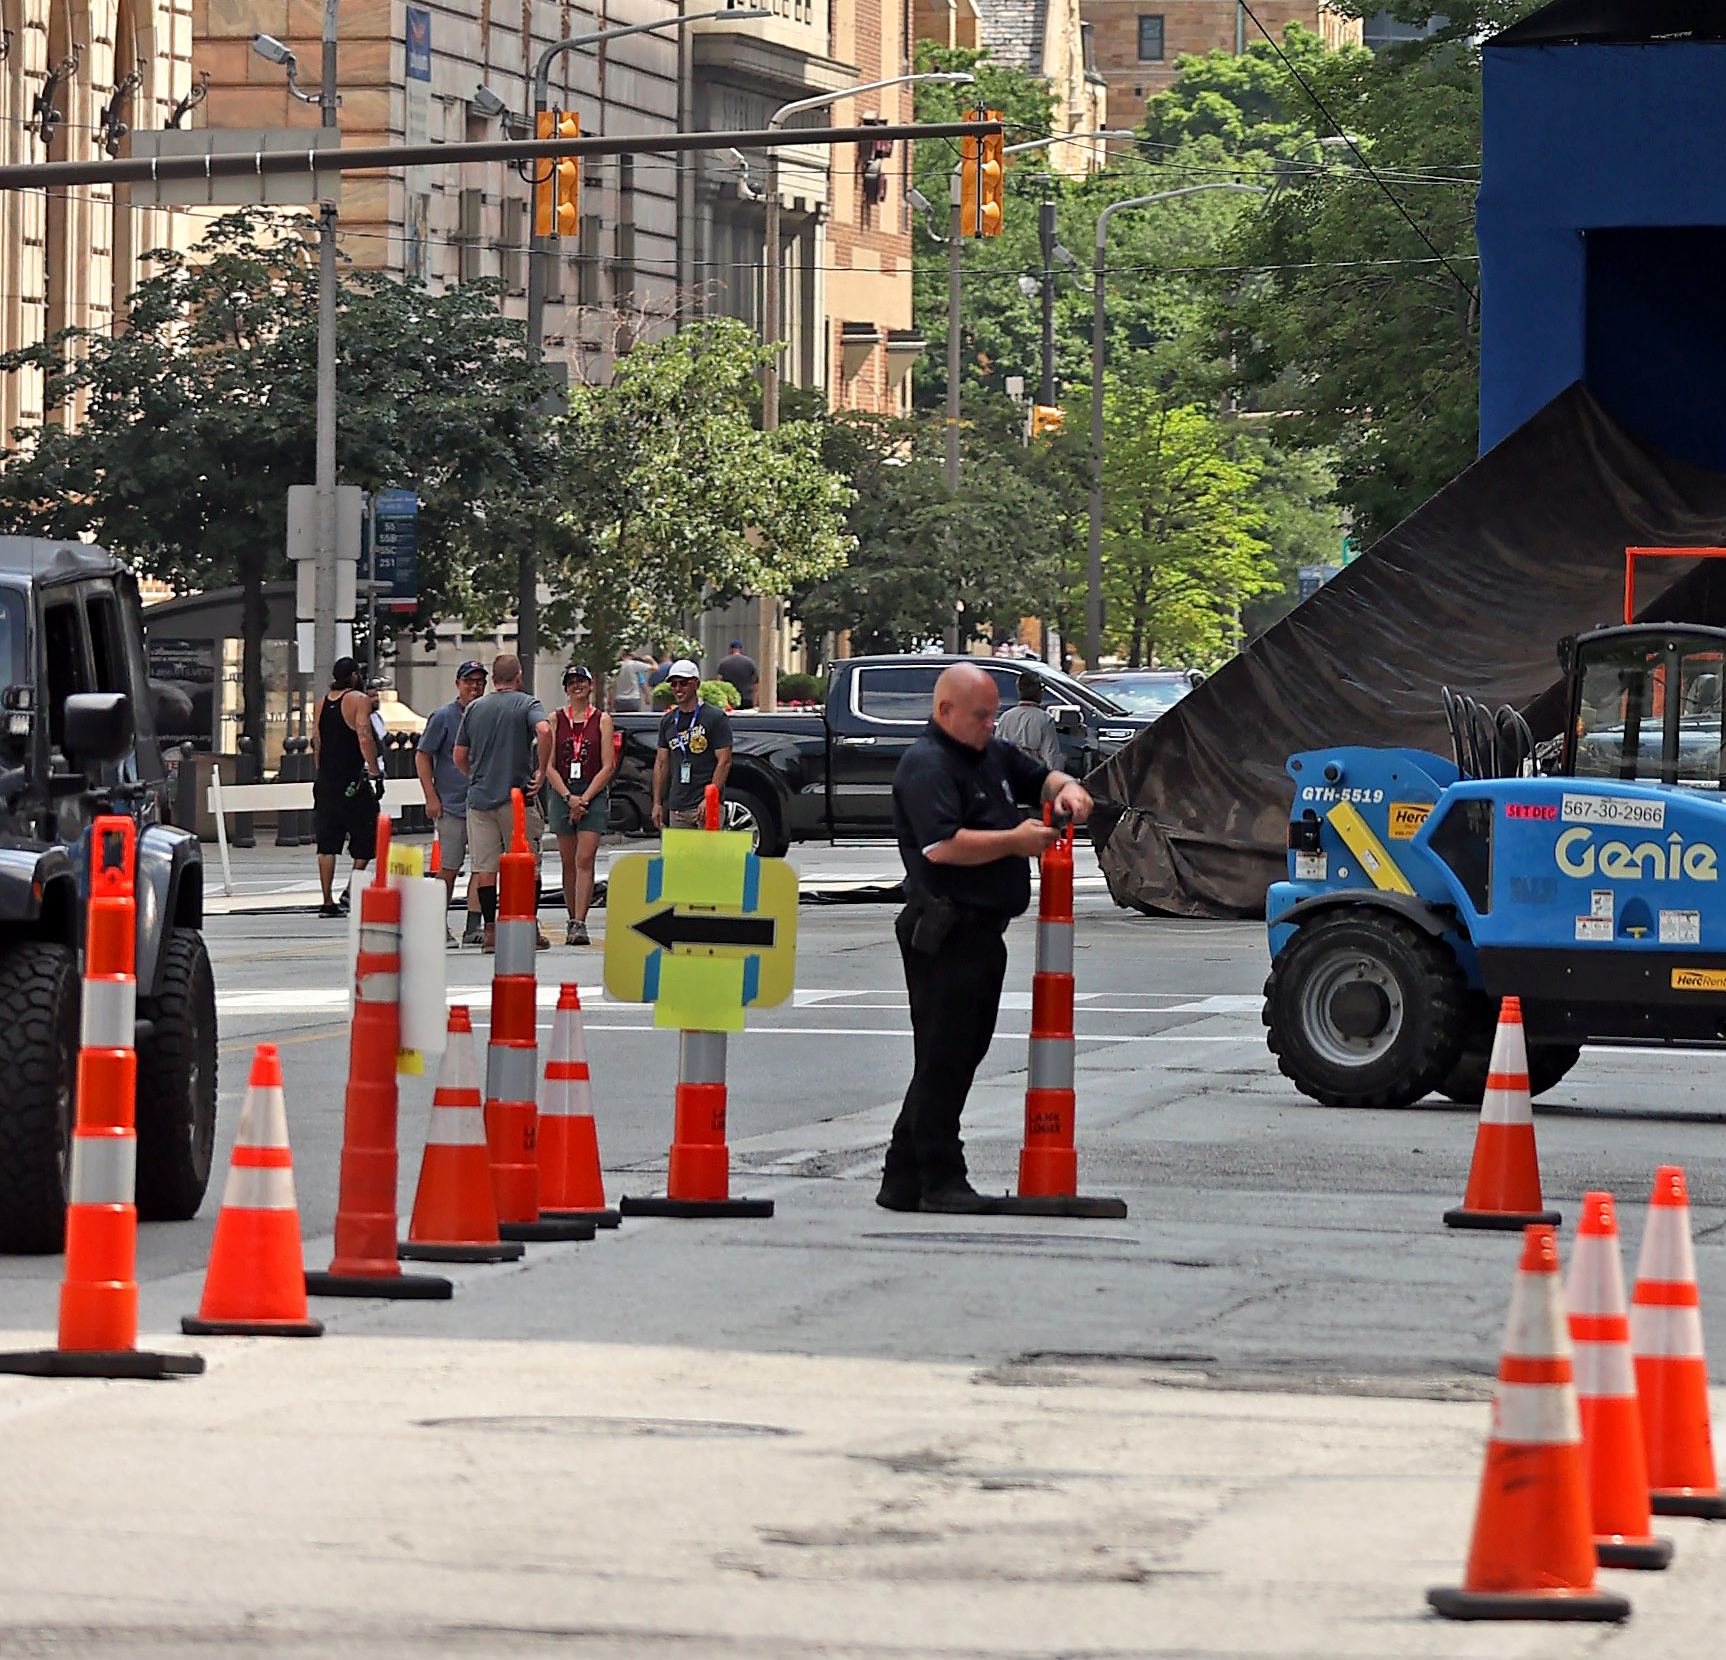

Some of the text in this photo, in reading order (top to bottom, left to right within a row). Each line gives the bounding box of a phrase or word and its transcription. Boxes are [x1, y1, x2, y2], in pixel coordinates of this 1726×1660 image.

[1302, 786, 1384, 804] GTH-5519
[1563, 800, 1662, 823] 567-30-2966
[1555, 826, 1718, 881] Genie
